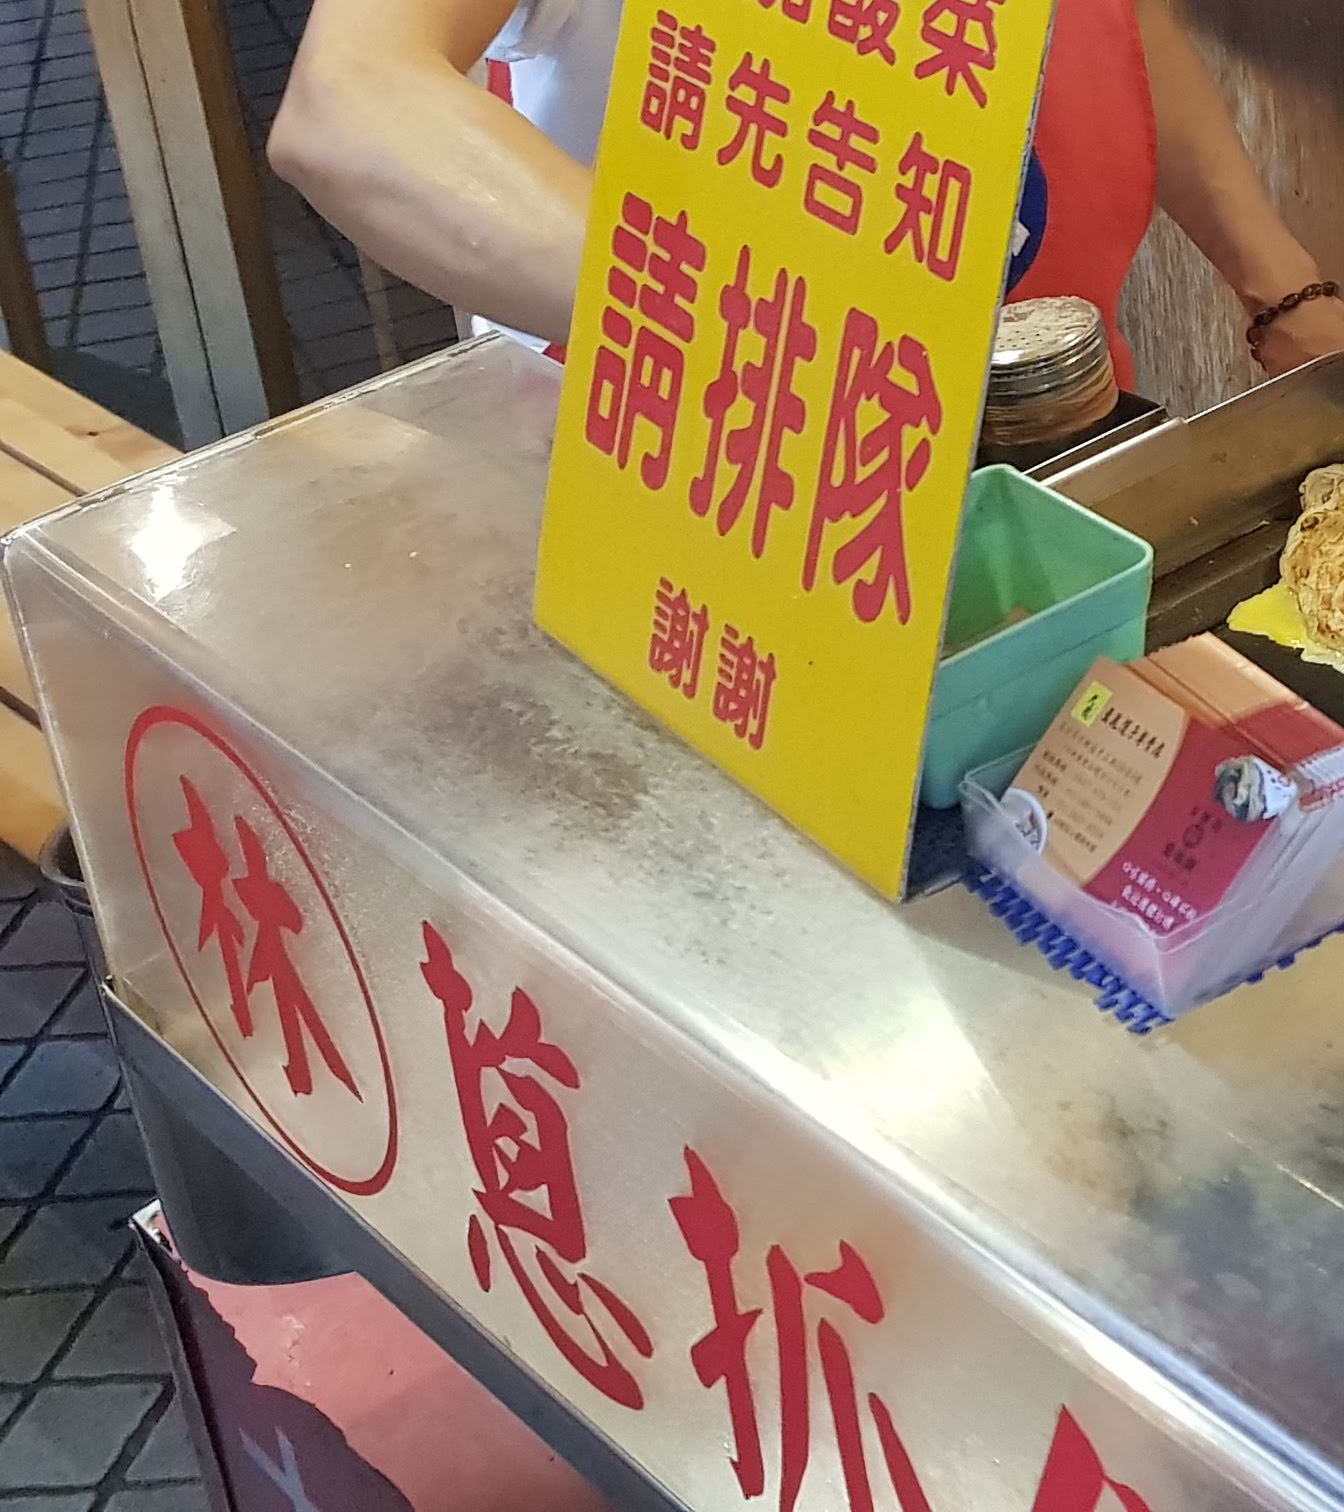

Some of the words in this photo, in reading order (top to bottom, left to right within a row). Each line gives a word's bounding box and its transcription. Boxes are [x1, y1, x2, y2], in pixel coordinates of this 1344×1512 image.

[638, 9, 973, 283] 請先告知
[585, 191, 944, 626] 請排隊
[647, 576, 778, 752] 謝謝
[171, 773, 364, 1103] 林
